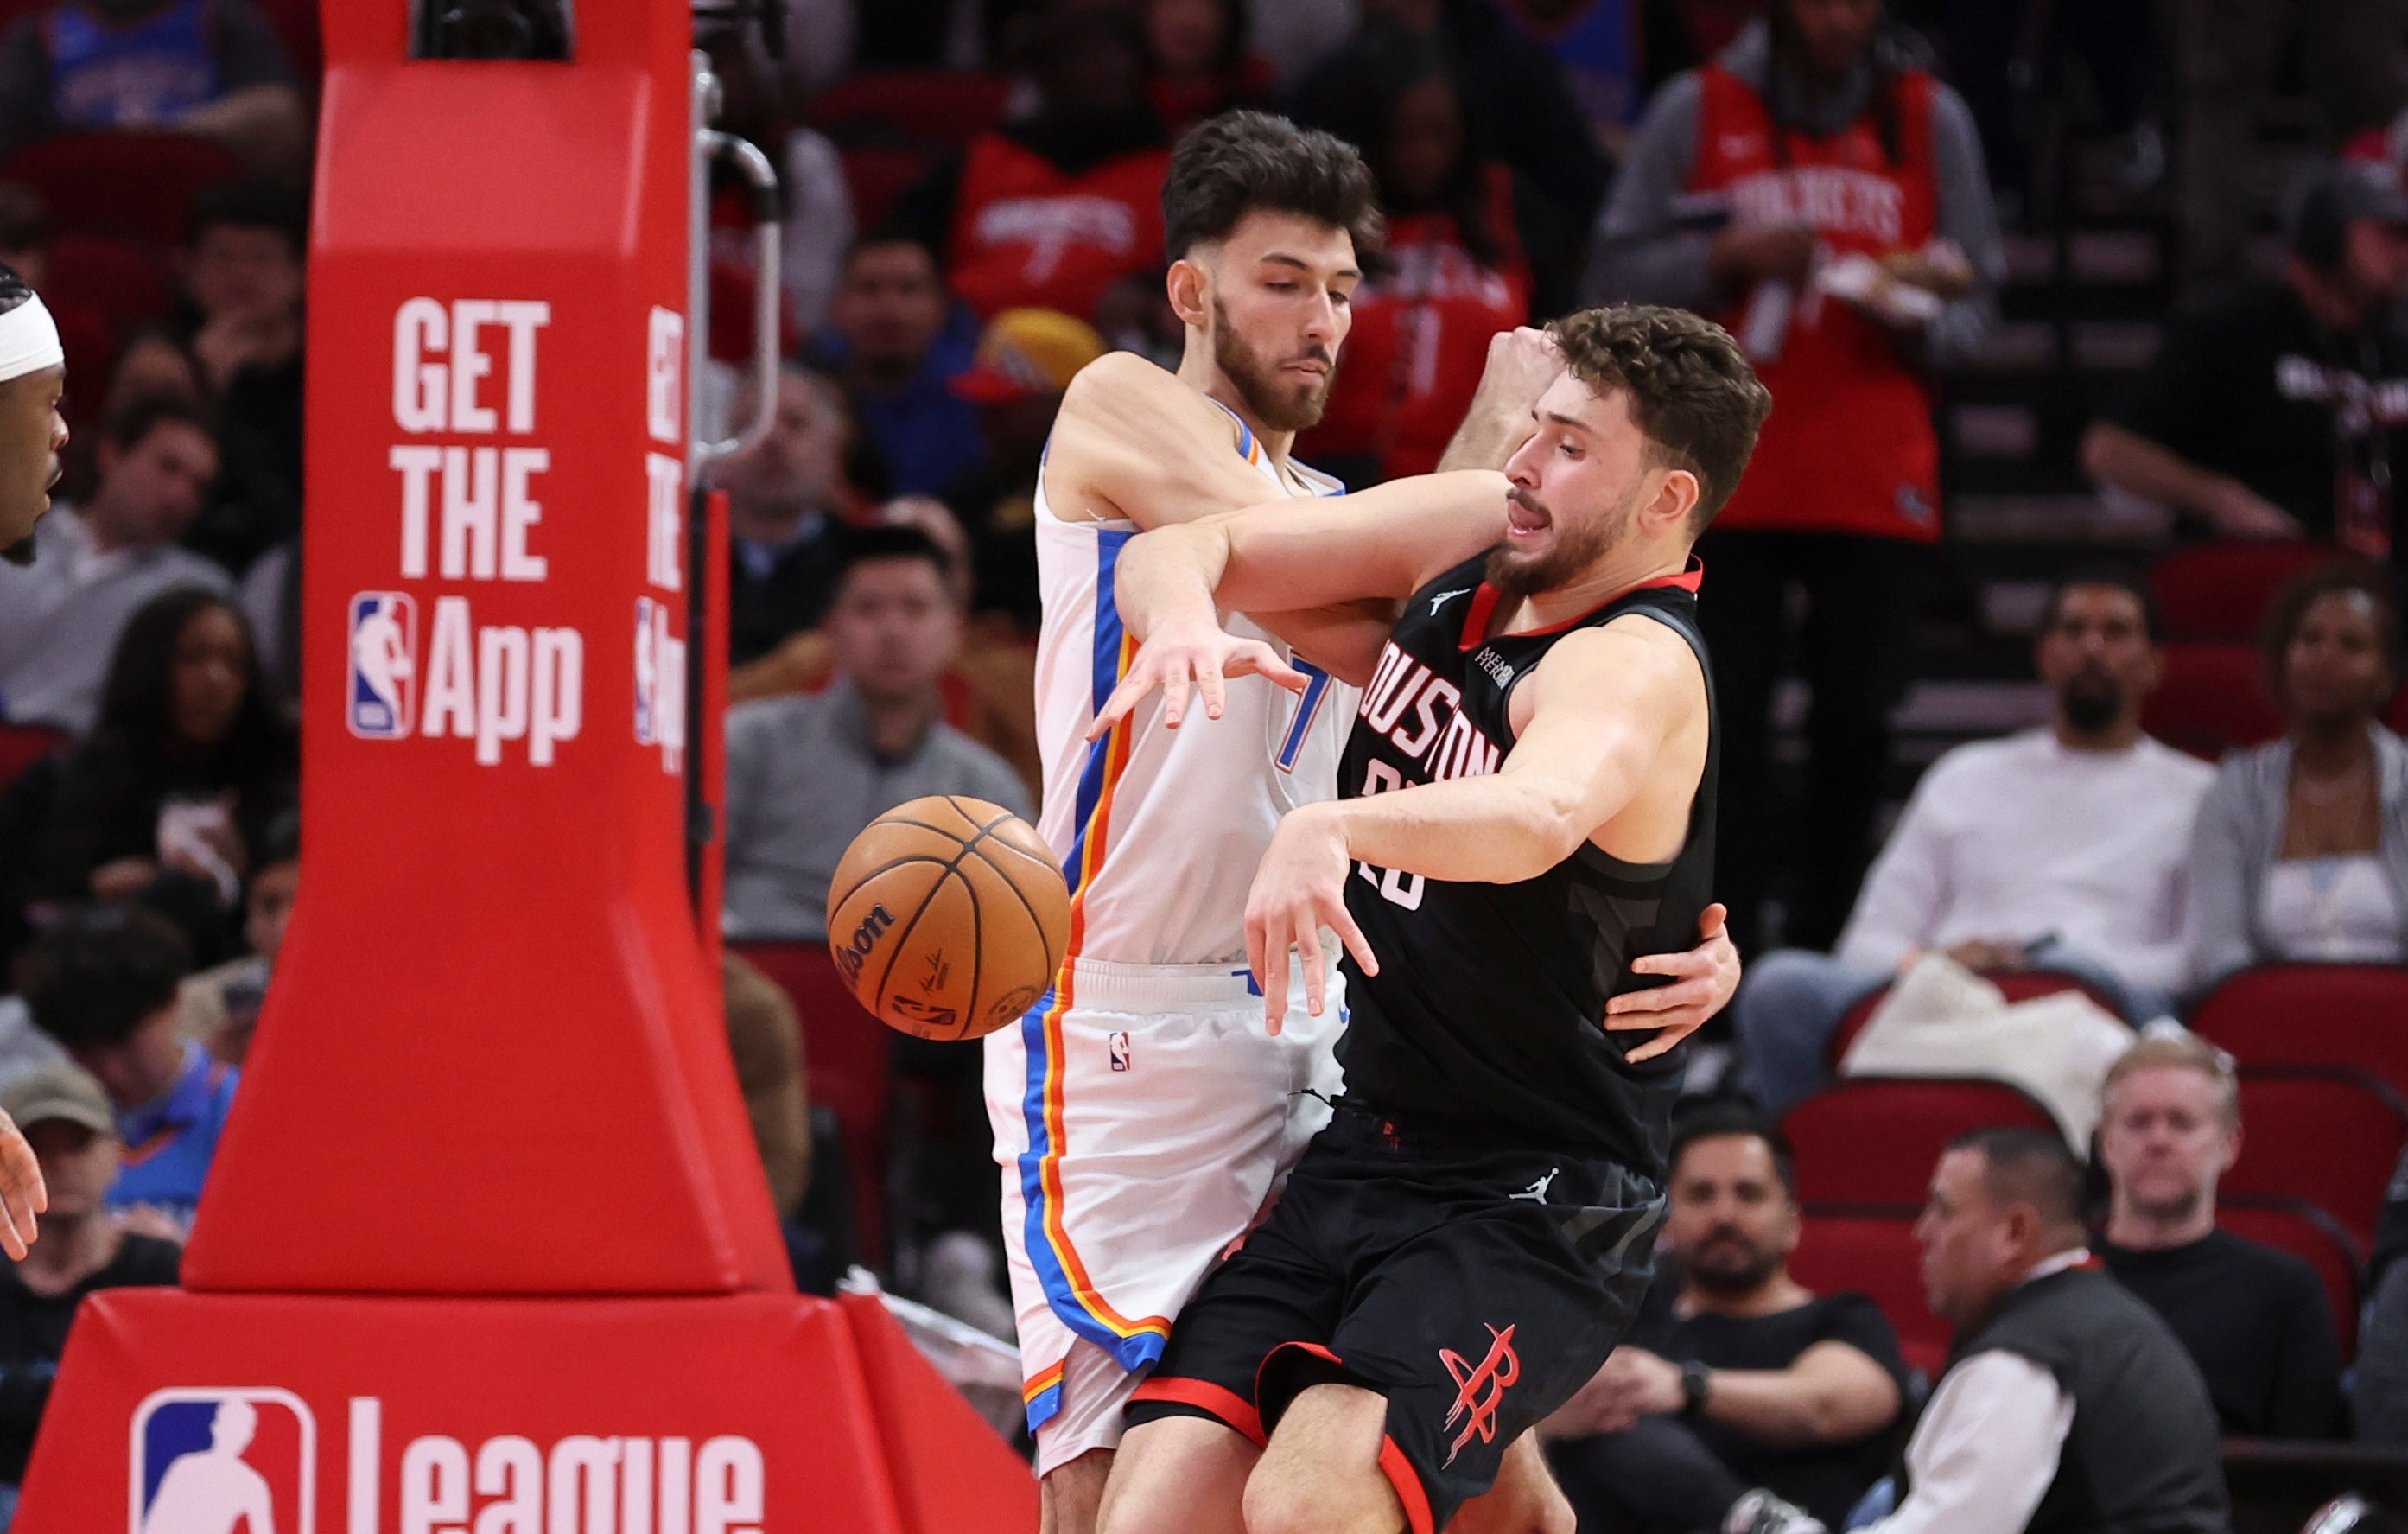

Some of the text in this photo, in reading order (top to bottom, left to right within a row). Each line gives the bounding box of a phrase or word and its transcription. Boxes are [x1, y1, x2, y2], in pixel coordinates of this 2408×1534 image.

[392, 296, 552, 433] GET
[389, 444, 550, 582] THE
[421, 595, 585, 767] App
[347, 1395, 766, 1534] League
